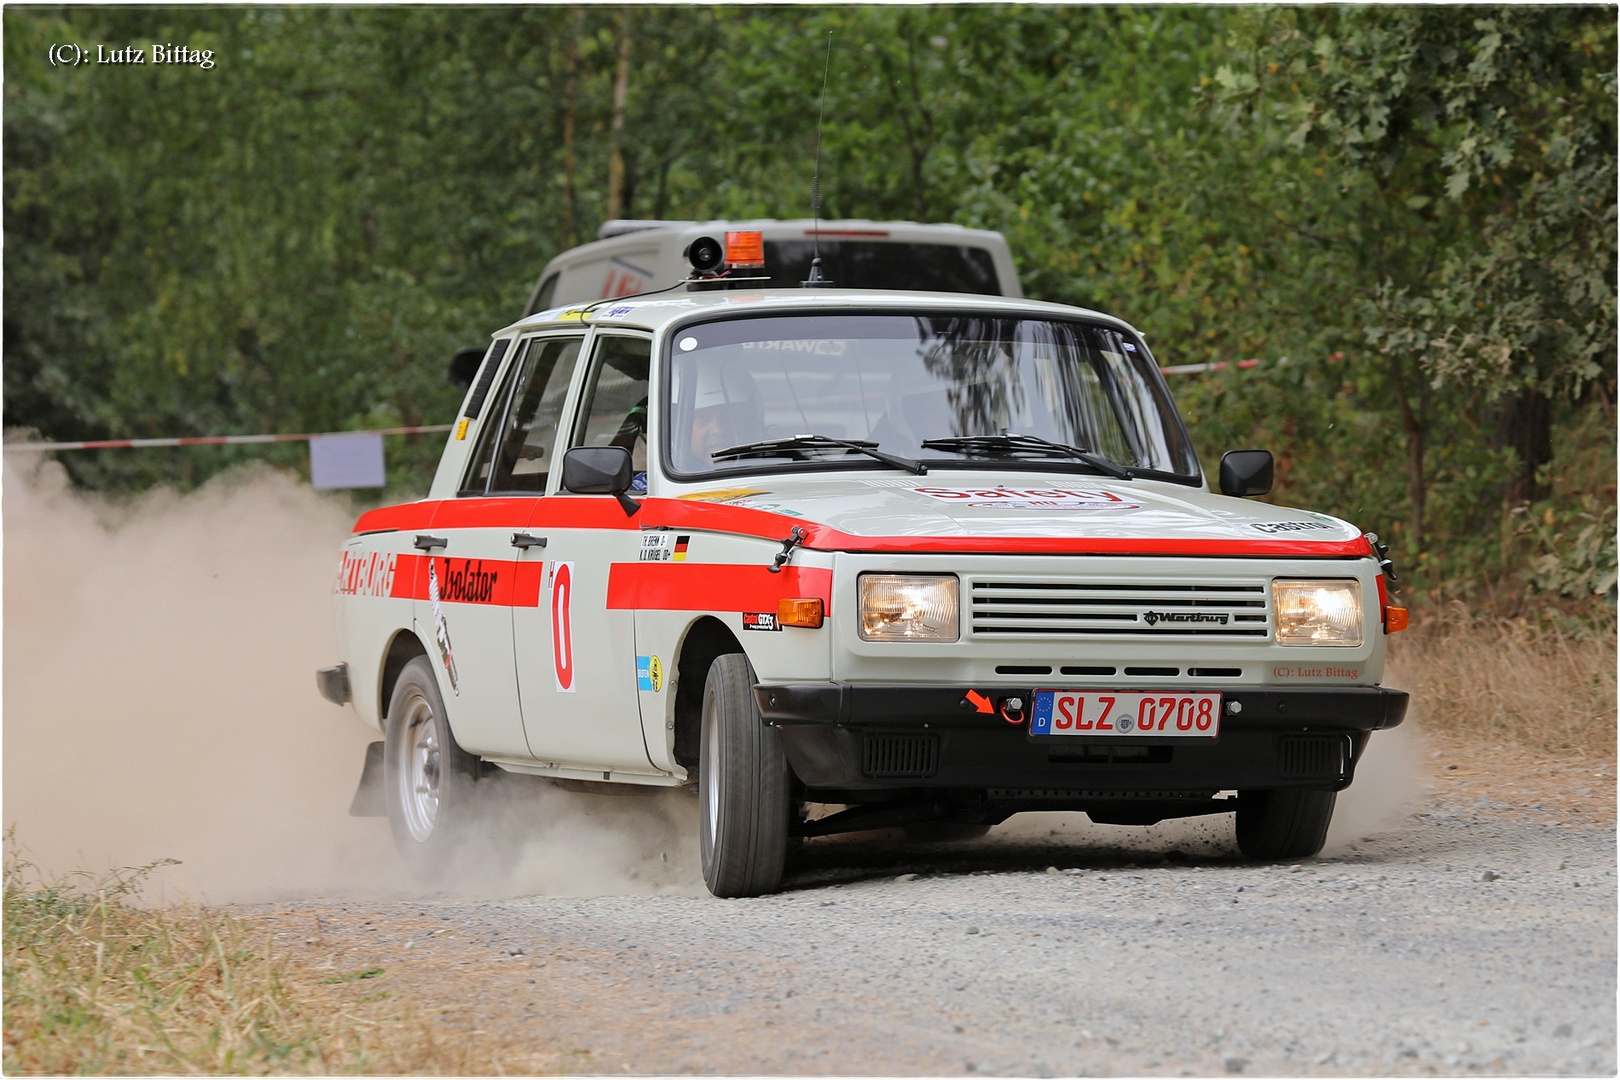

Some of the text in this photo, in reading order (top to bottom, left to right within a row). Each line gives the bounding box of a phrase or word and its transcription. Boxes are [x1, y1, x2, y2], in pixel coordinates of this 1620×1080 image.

[914, 487, 1124, 502] Safety
[1250, 522, 1335, 533] Castrol
[1159, 612, 1229, 625] Wartburg
[1055, 696, 1213, 731] SLZ 0708
[1037, 717, 1046, 727] D
